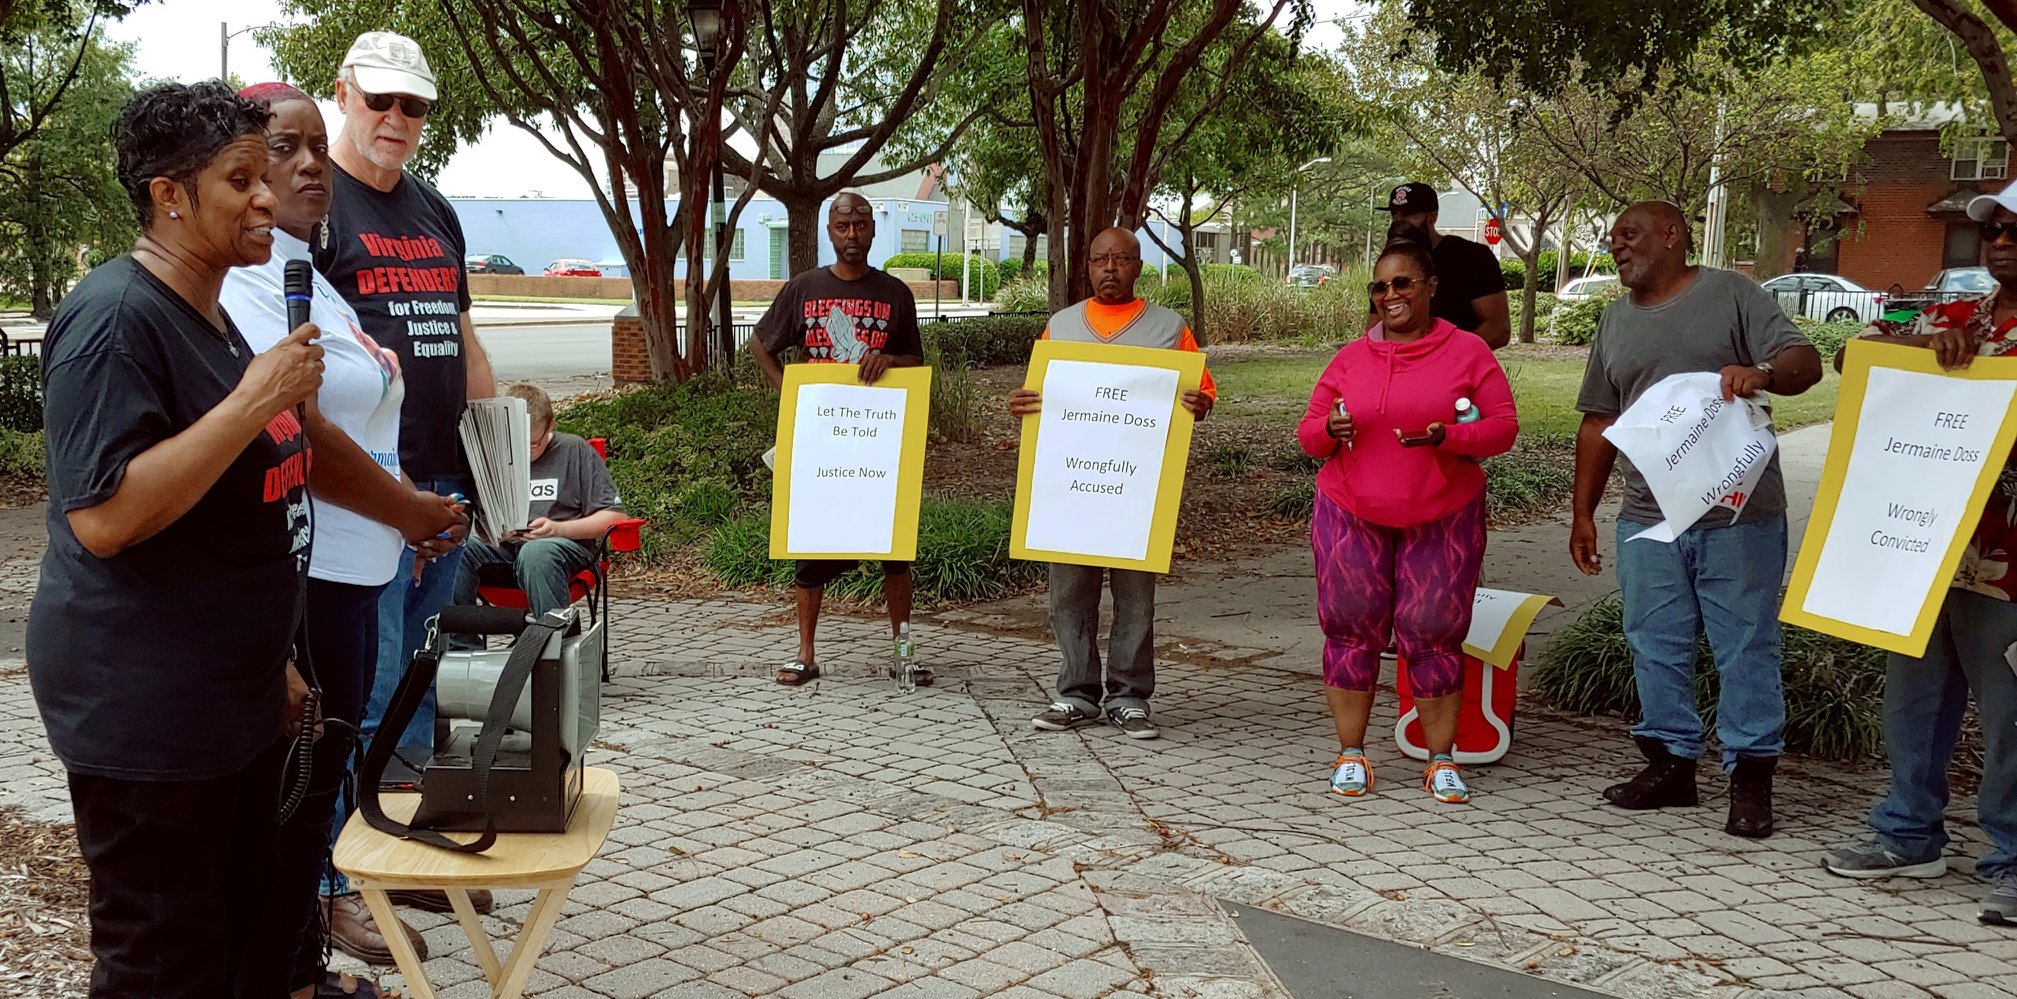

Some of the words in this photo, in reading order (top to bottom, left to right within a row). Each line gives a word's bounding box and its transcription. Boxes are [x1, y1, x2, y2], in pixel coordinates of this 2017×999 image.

[1485, 226, 1501, 238] STO
[358, 233, 445, 262] Virginia
[356, 266, 458, 295] DEFENDERS
[388, 301, 410, 316] for
[873, 301, 891, 321] ON
[407, 320, 450, 336] Justice
[413, 340, 459, 358] Equality
[1094, 386, 1129, 402] FREE
[817, 406, 836, 417] Let
[839, 407, 861, 418] The
[864, 408, 897, 420] Truth
[1061, 408, 1120, 424] Jermaine
[1123, 413, 1157, 428] Doss
[1660, 404, 1687, 424] FREE
[1933, 411, 1970, 430] FREE
[832, 425, 848, 437] Be
[851, 426, 878, 438] Told
[1665, 417, 1709, 471] Jermaine
[1884, 437, 1951, 461] Jermaine
[1952, 446, 1980, 463] Doss
[816, 466, 855, 478] Justice
[858, 467, 887, 479] Now
[1065, 456, 1138, 477] Wrongfully
[1701, 440, 1766, 506] Wrongfully
[1069, 479, 1124, 495] Accused
[1887, 502, 1939, 528] Wrongly
[1870, 530, 1931, 553] Convicted
